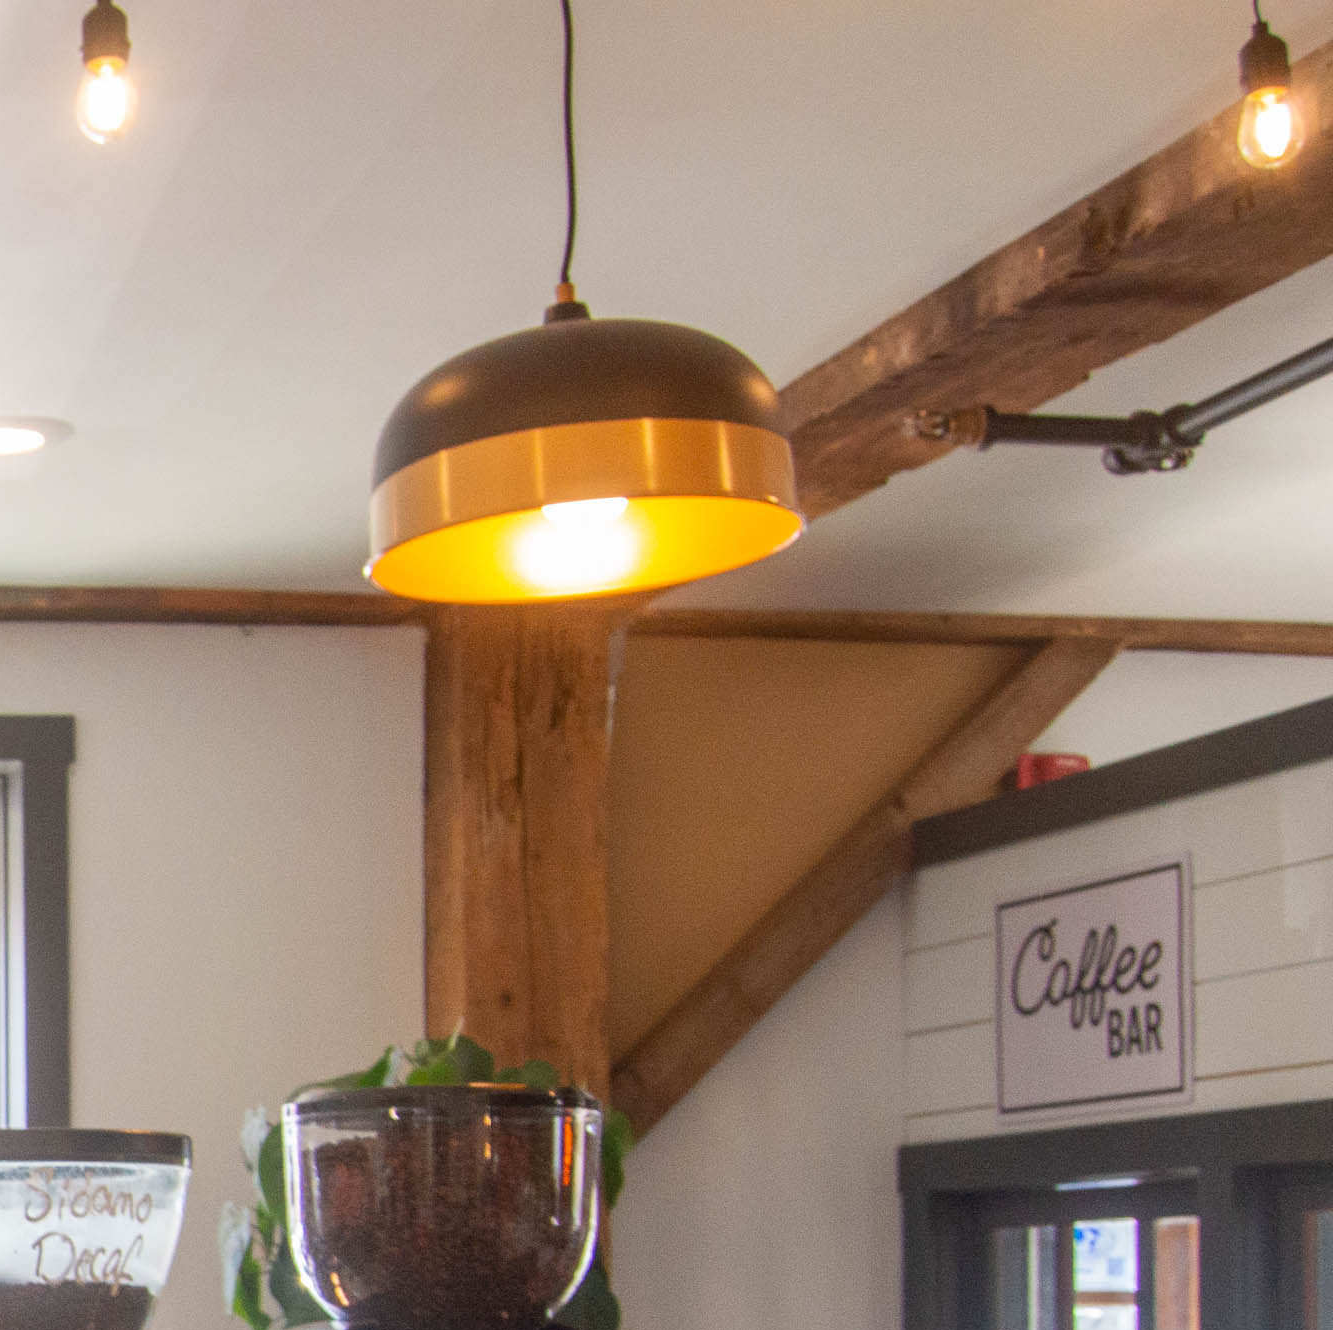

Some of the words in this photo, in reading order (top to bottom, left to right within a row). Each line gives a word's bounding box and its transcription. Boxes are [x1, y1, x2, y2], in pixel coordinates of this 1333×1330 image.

[1011, 917, 1163, 1031] Coffee
[1106, 1002, 1163, 1059] BAR
[23, 1166, 153, 1224] Sidamo
[31, 1231, 144, 1297] Decaf
